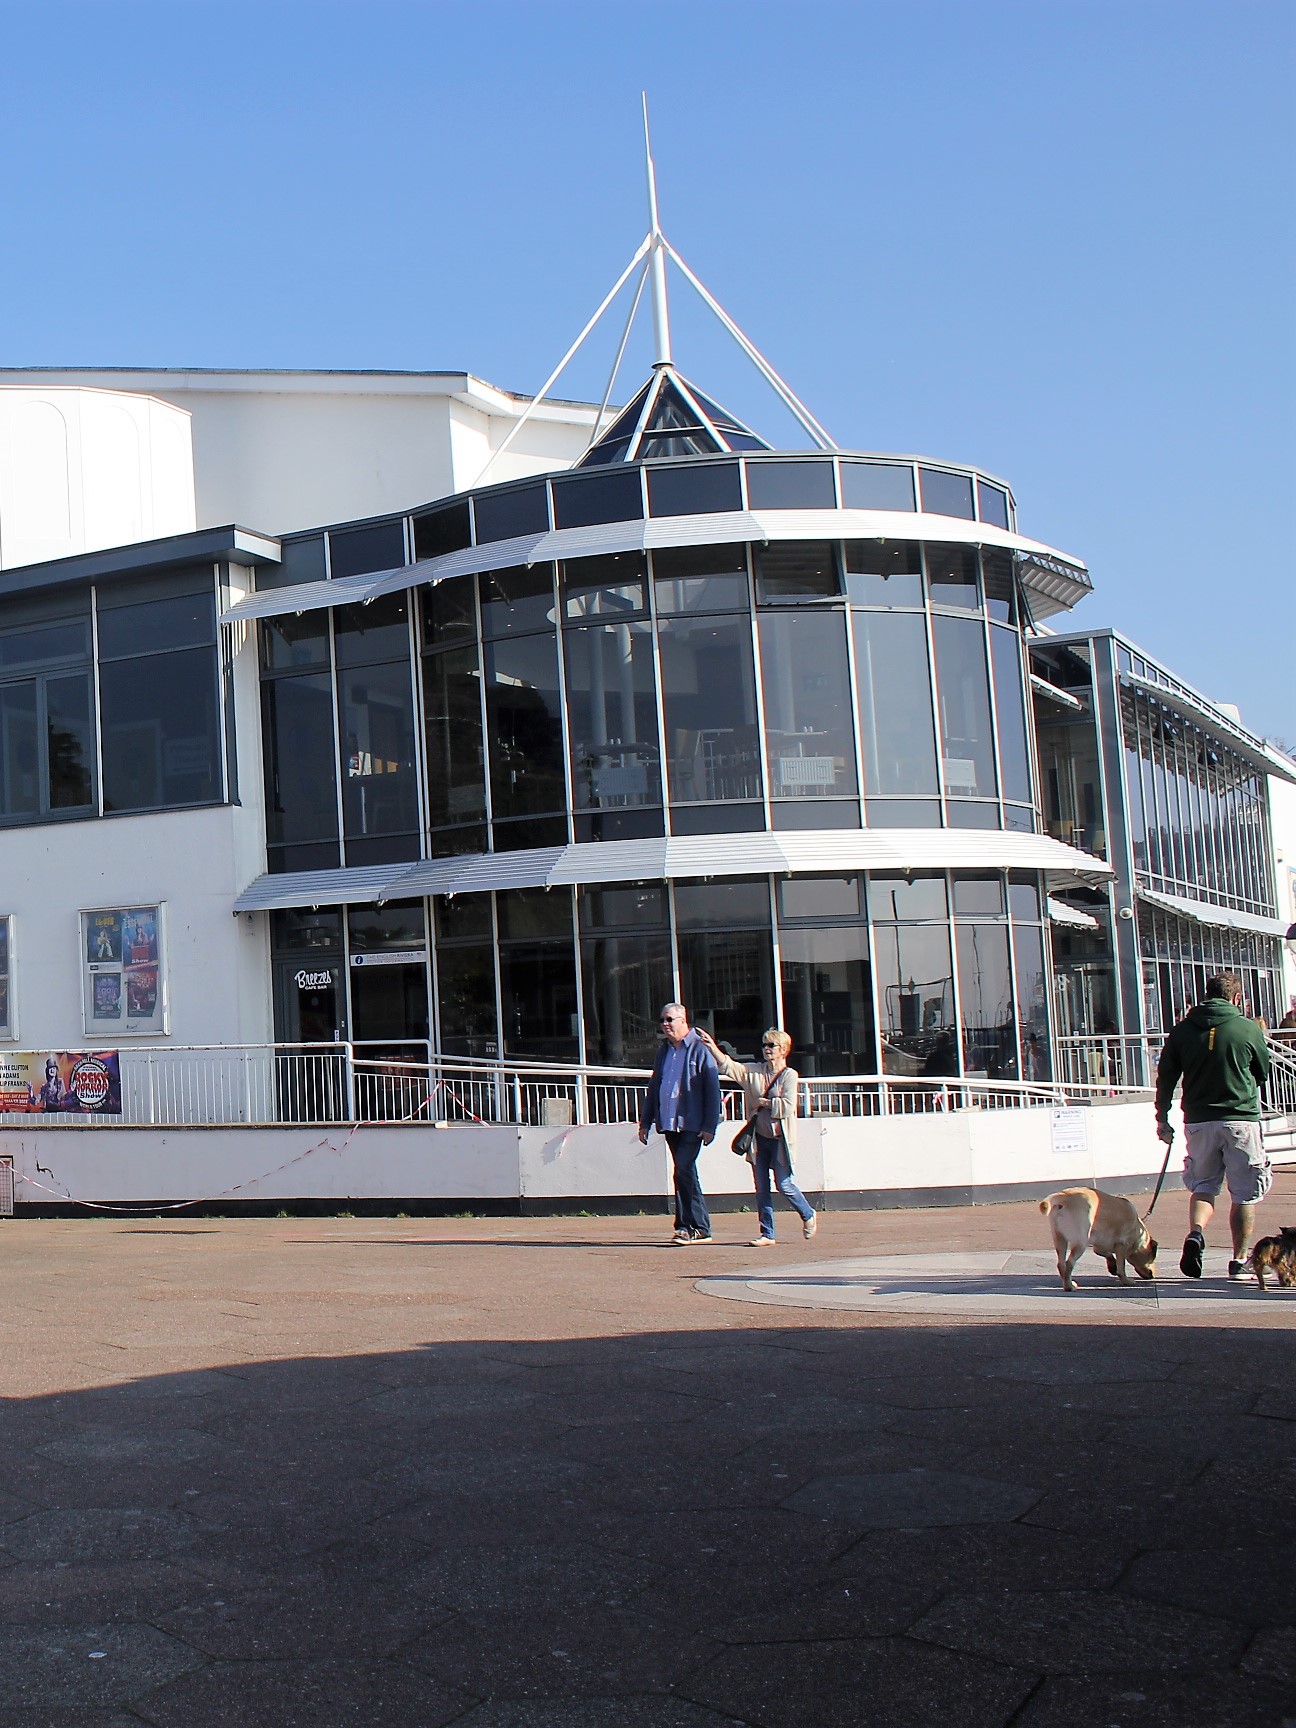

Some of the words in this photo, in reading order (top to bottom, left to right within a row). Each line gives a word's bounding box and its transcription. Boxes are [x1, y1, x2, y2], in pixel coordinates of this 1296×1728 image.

[294, 970, 331, 988] Breezes
[75, 1072, 109, 1083] ROCKY
[76, 1083, 108, 1091] HORROR
